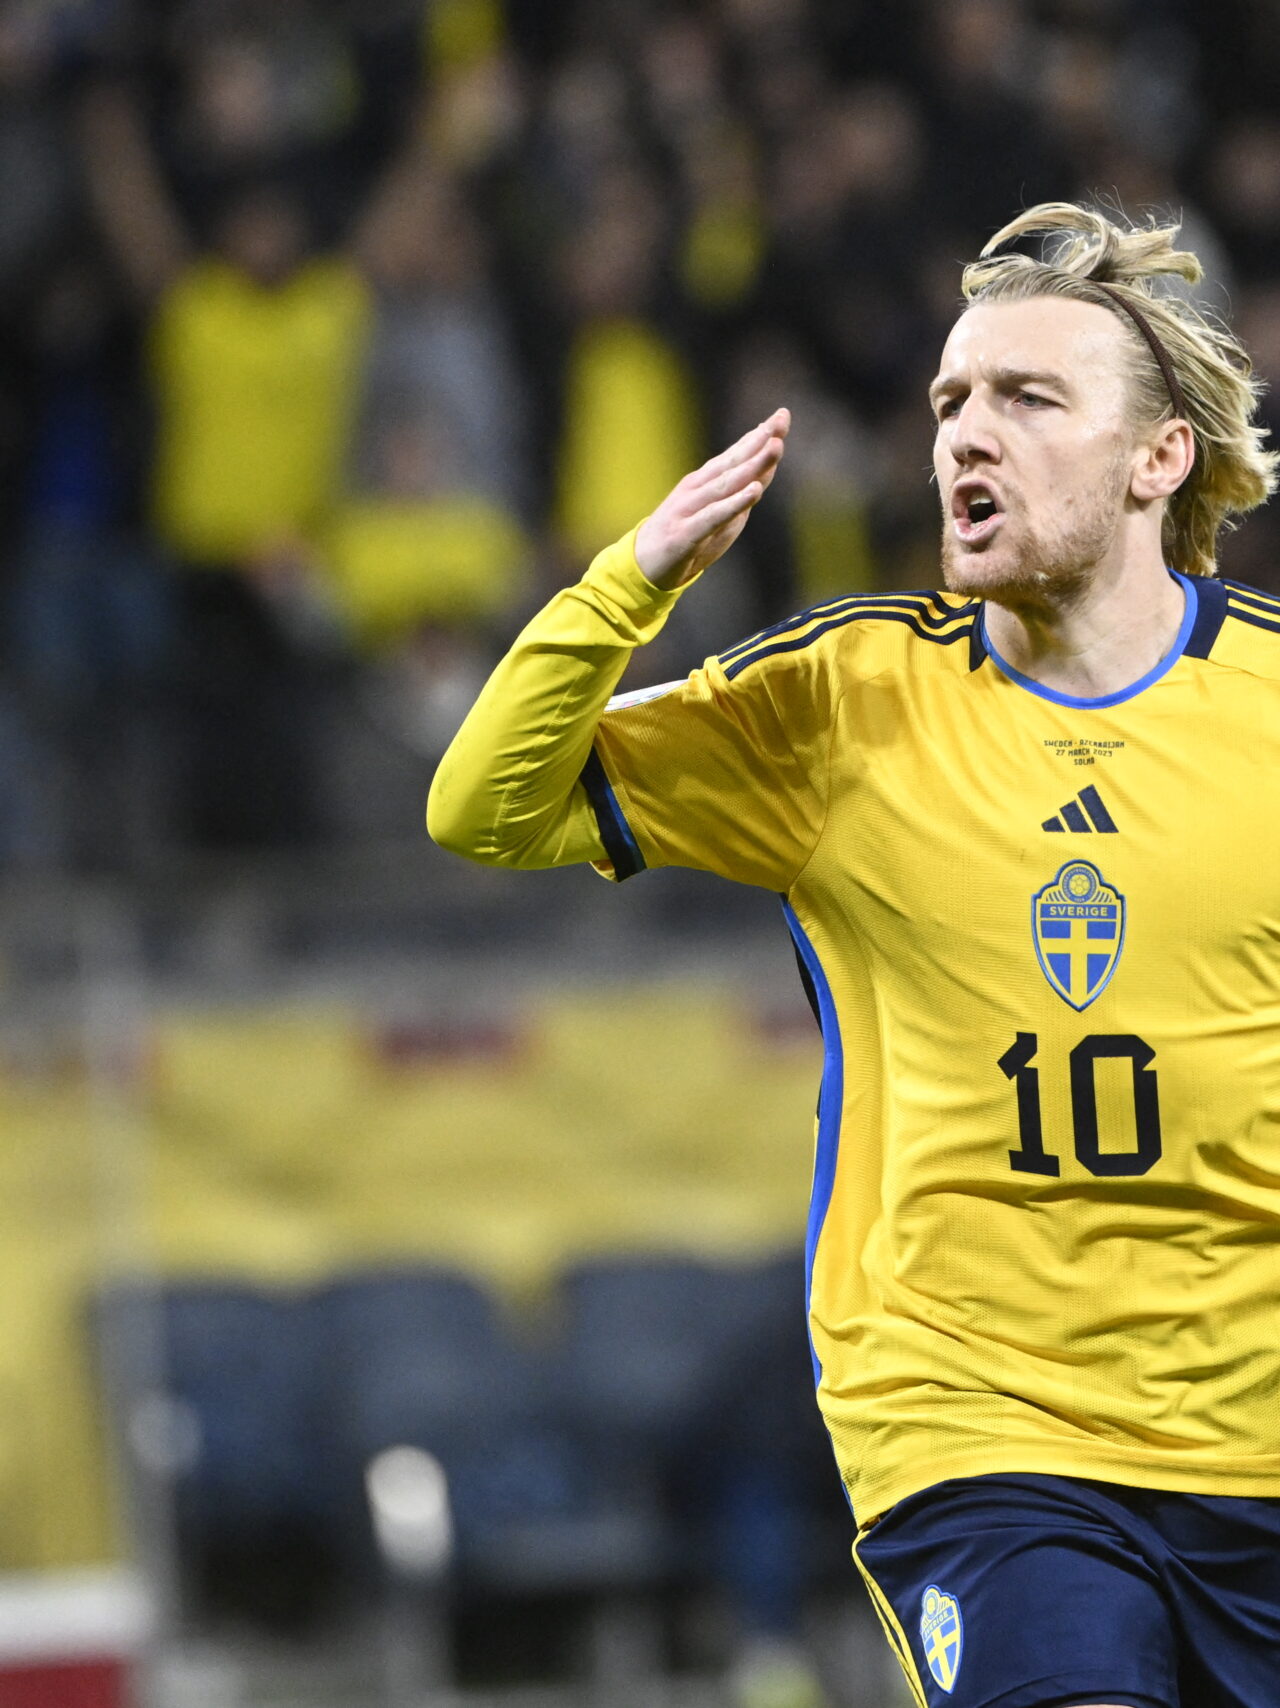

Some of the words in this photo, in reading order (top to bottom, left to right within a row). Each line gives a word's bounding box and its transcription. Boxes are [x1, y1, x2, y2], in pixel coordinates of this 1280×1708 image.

[1043, 739, 1073, 748] SWEDEN
[1079, 738, 1125, 749] AZERBAIJAN
[1055, 749, 1066, 757] 27
[1067, 747, 1090, 757] MARCH
[1092, 748, 1113, 758] 2023
[1073, 756, 1095, 766] SOLNA
[1050, 906, 1109, 917] SVERIGE
[997, 1031, 1162, 1178] 10
[922, 1610, 949, 1640] SVERIGE
